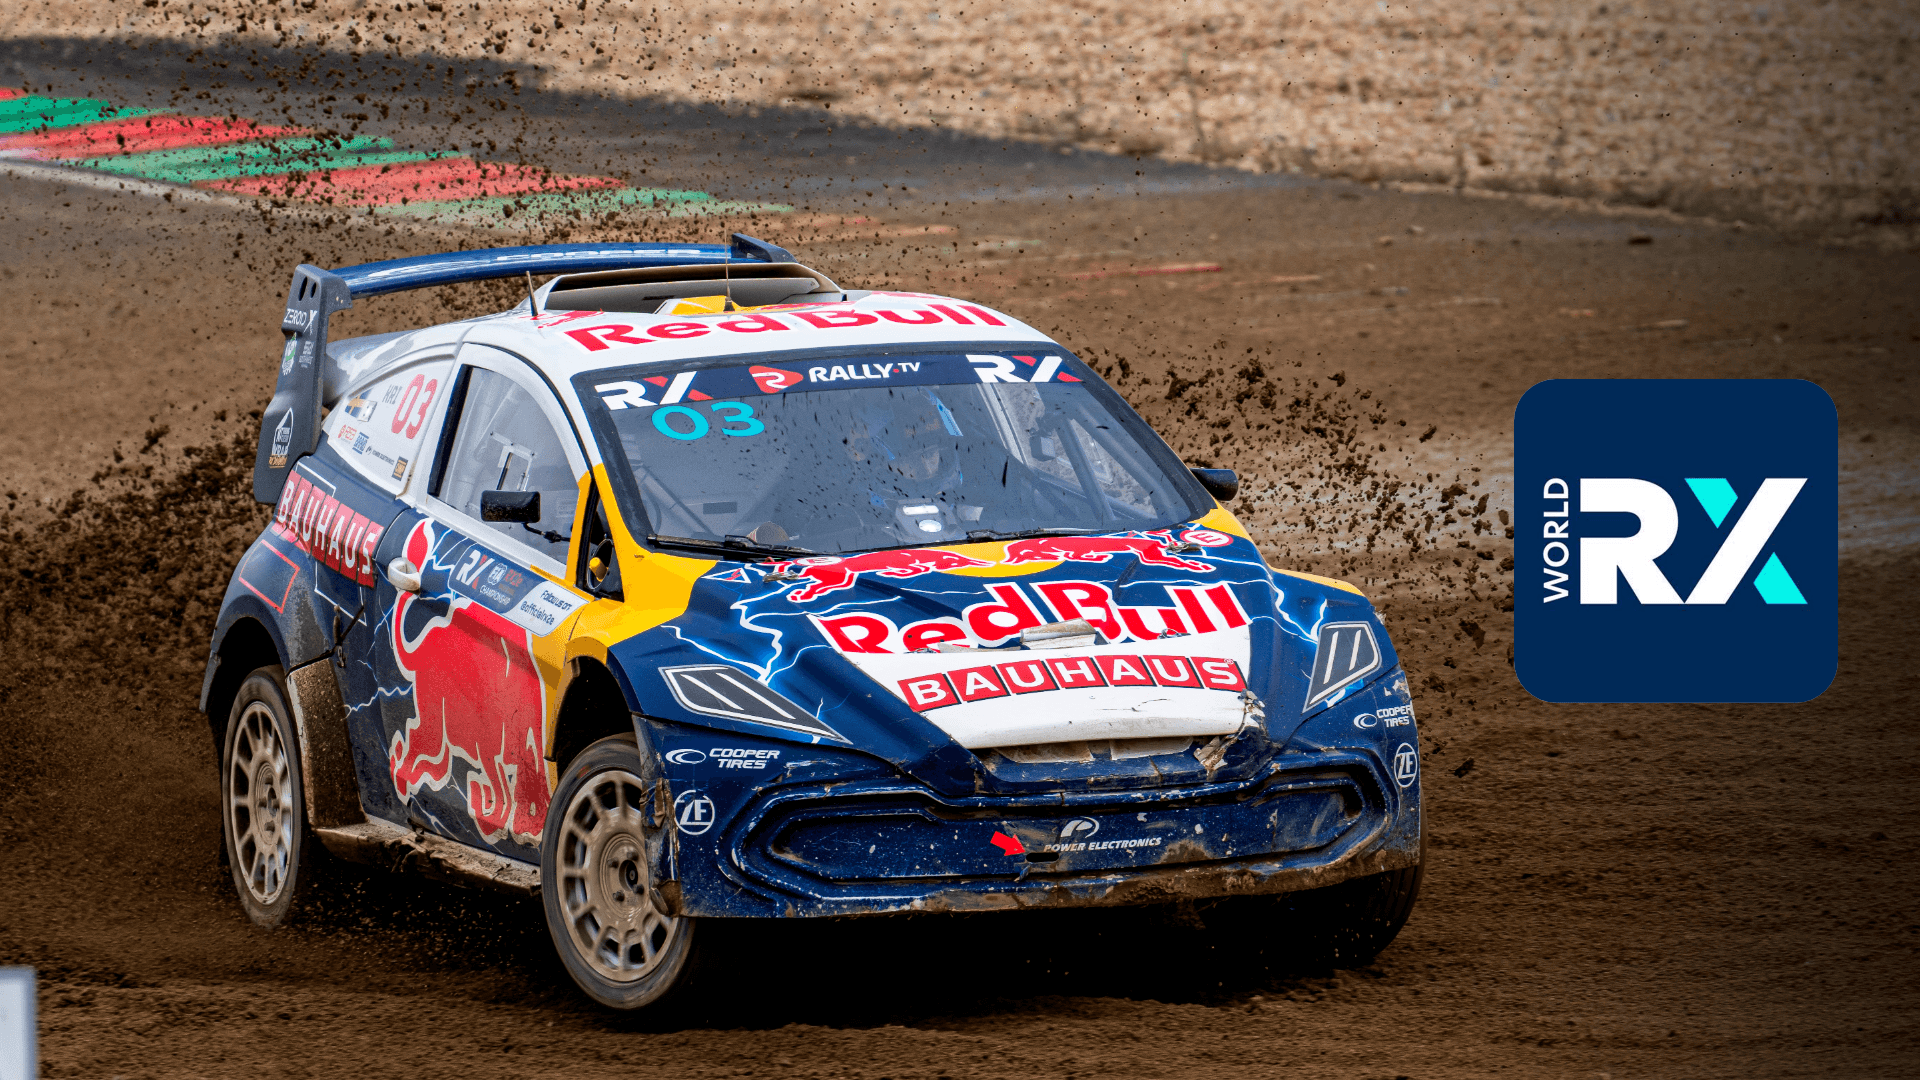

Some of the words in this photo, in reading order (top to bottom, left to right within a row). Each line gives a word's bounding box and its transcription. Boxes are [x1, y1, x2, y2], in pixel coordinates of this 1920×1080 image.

[564, 314, 791, 352] Red
[786, 304, 1008, 330] Bull
[965, 354, 1085, 384] RX
[391, 374, 438, 440] 03
[595, 371, 713, 411] RX
[651, 401, 766, 441] 03
[278, 479, 376, 575] BAUHAUS
[456, 550, 495, 589] RX
[818, 582, 1042, 653] Red
[1037, 582, 1248, 641] Bull
[1376, 705, 1411, 718] COOPER
[1384, 716, 1409, 727] TIRES
[709, 748, 780, 759] COOPER
[718, 759, 767, 769] TIRES
[1044, 843, 1086, 852] POWER
[1088, 837, 1162, 851] ELECTRONICS
